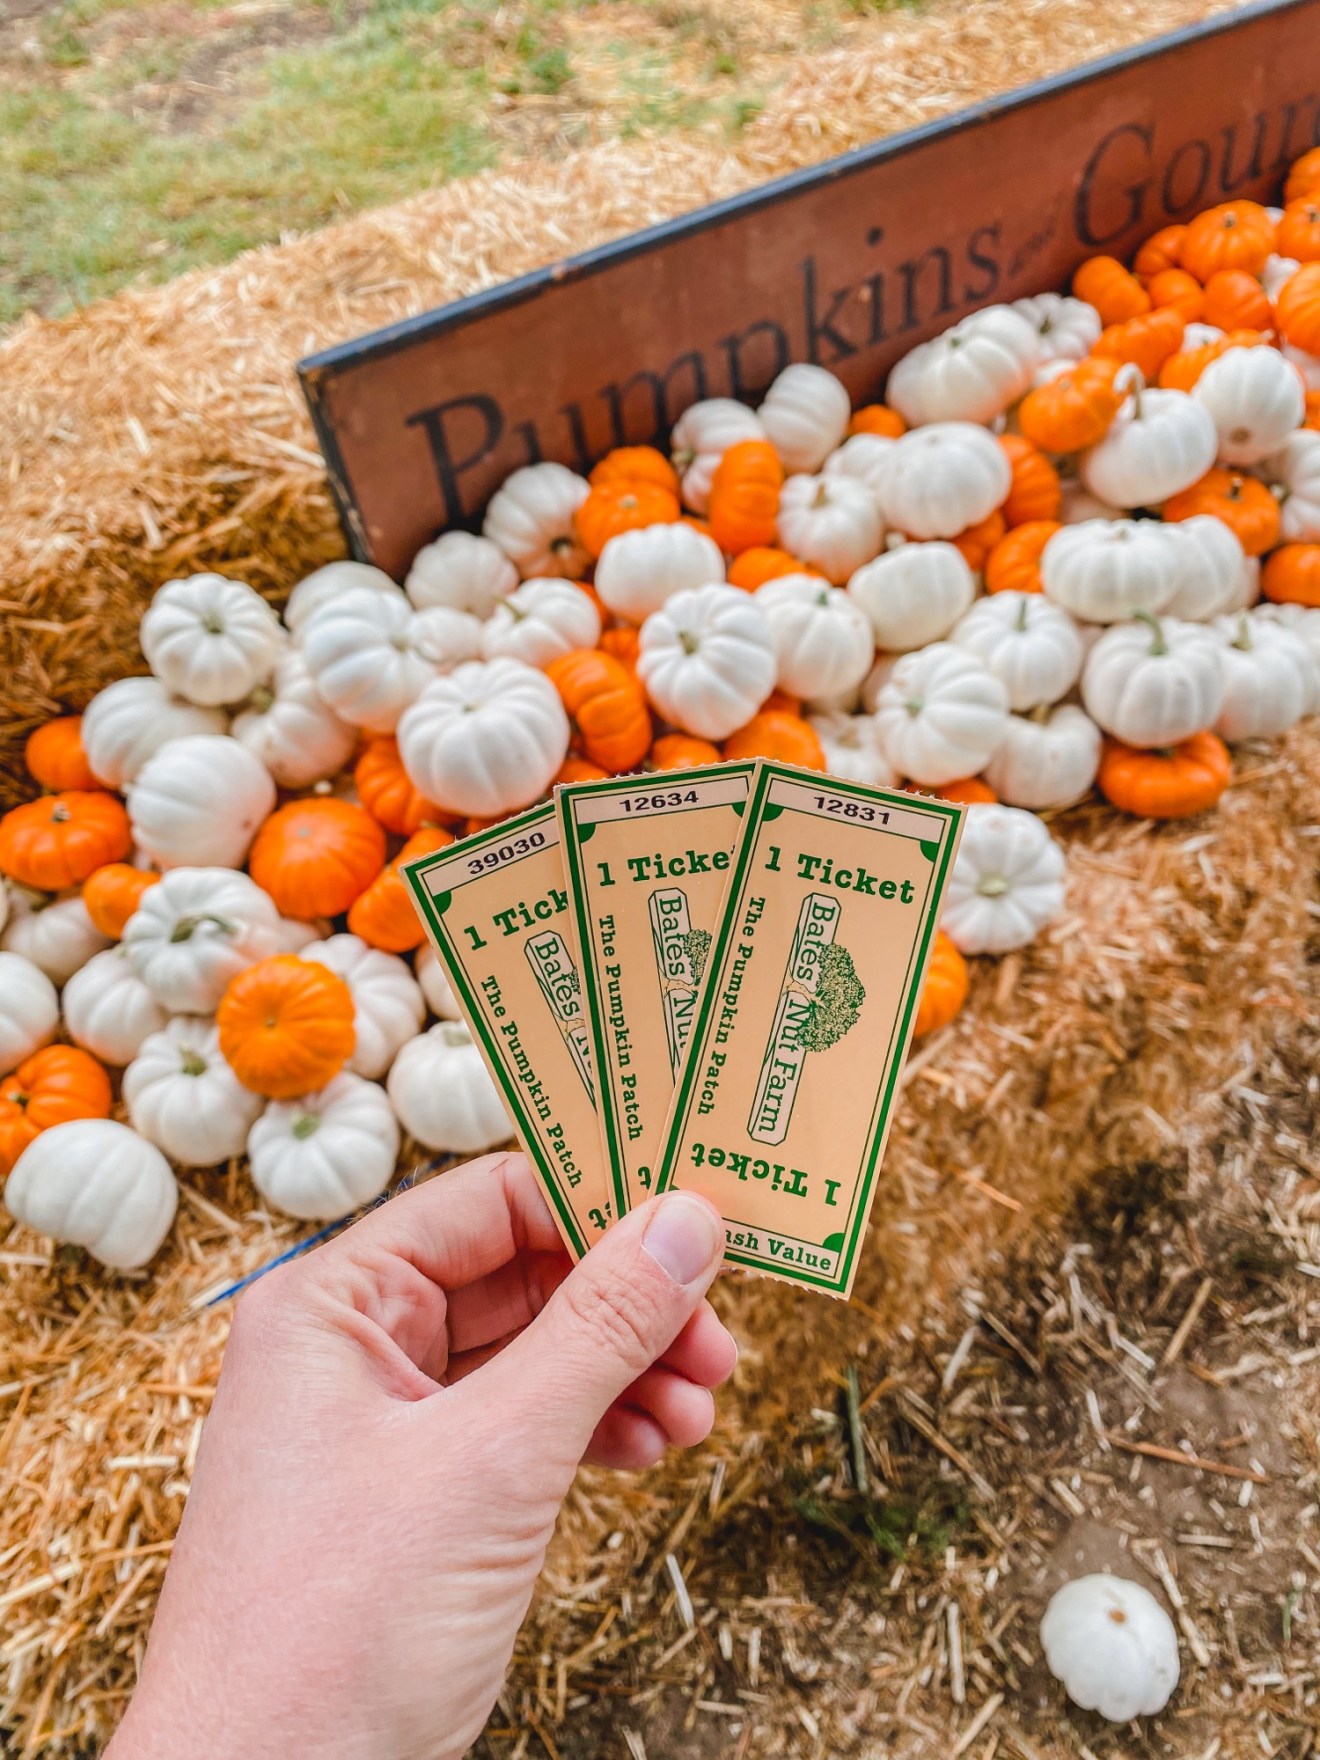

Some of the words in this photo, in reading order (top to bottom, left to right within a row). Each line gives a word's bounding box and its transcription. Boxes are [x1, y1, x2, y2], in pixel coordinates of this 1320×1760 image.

[405, 226, 1001, 533] Pumpkins
[1074, 92, 1320, 247] Gour
[619, 790, 699, 812] 12634
[813, 796, 891, 825] 12831
[467, 832, 546, 875] 39030
[597, 862, 616, 887] 1
[627, 845, 736, 882] Ticke
[764, 845, 781, 872] 1
[797, 853, 915, 904] Ticket
[464, 925, 487, 951] 1
[599, 915, 616, 957] The
[659, 896, 685, 976] Bates
[742, 897, 766, 937] The
[796, 902, 836, 981] Bates
[535, 937, 581, 1018] Bates
[715, 943, 754, 1044] Pumpkin
[605, 963, 631, 1068] Pumpkin
[778, 999, 813, 1052] Nut
[481, 975, 508, 1018] The
[500, 1021, 552, 1121] Pumpkin
[546, 1123, 583, 1188] Patch
[620, 1074, 642, 1140] Patch
[697, 1050, 727, 1115] Patch
[758, 1057, 798, 1133] Farm
[690, 1142, 808, 1198] Ticket
[824, 1178, 842, 1207] 1
[767, 1238, 831, 1271] Value
